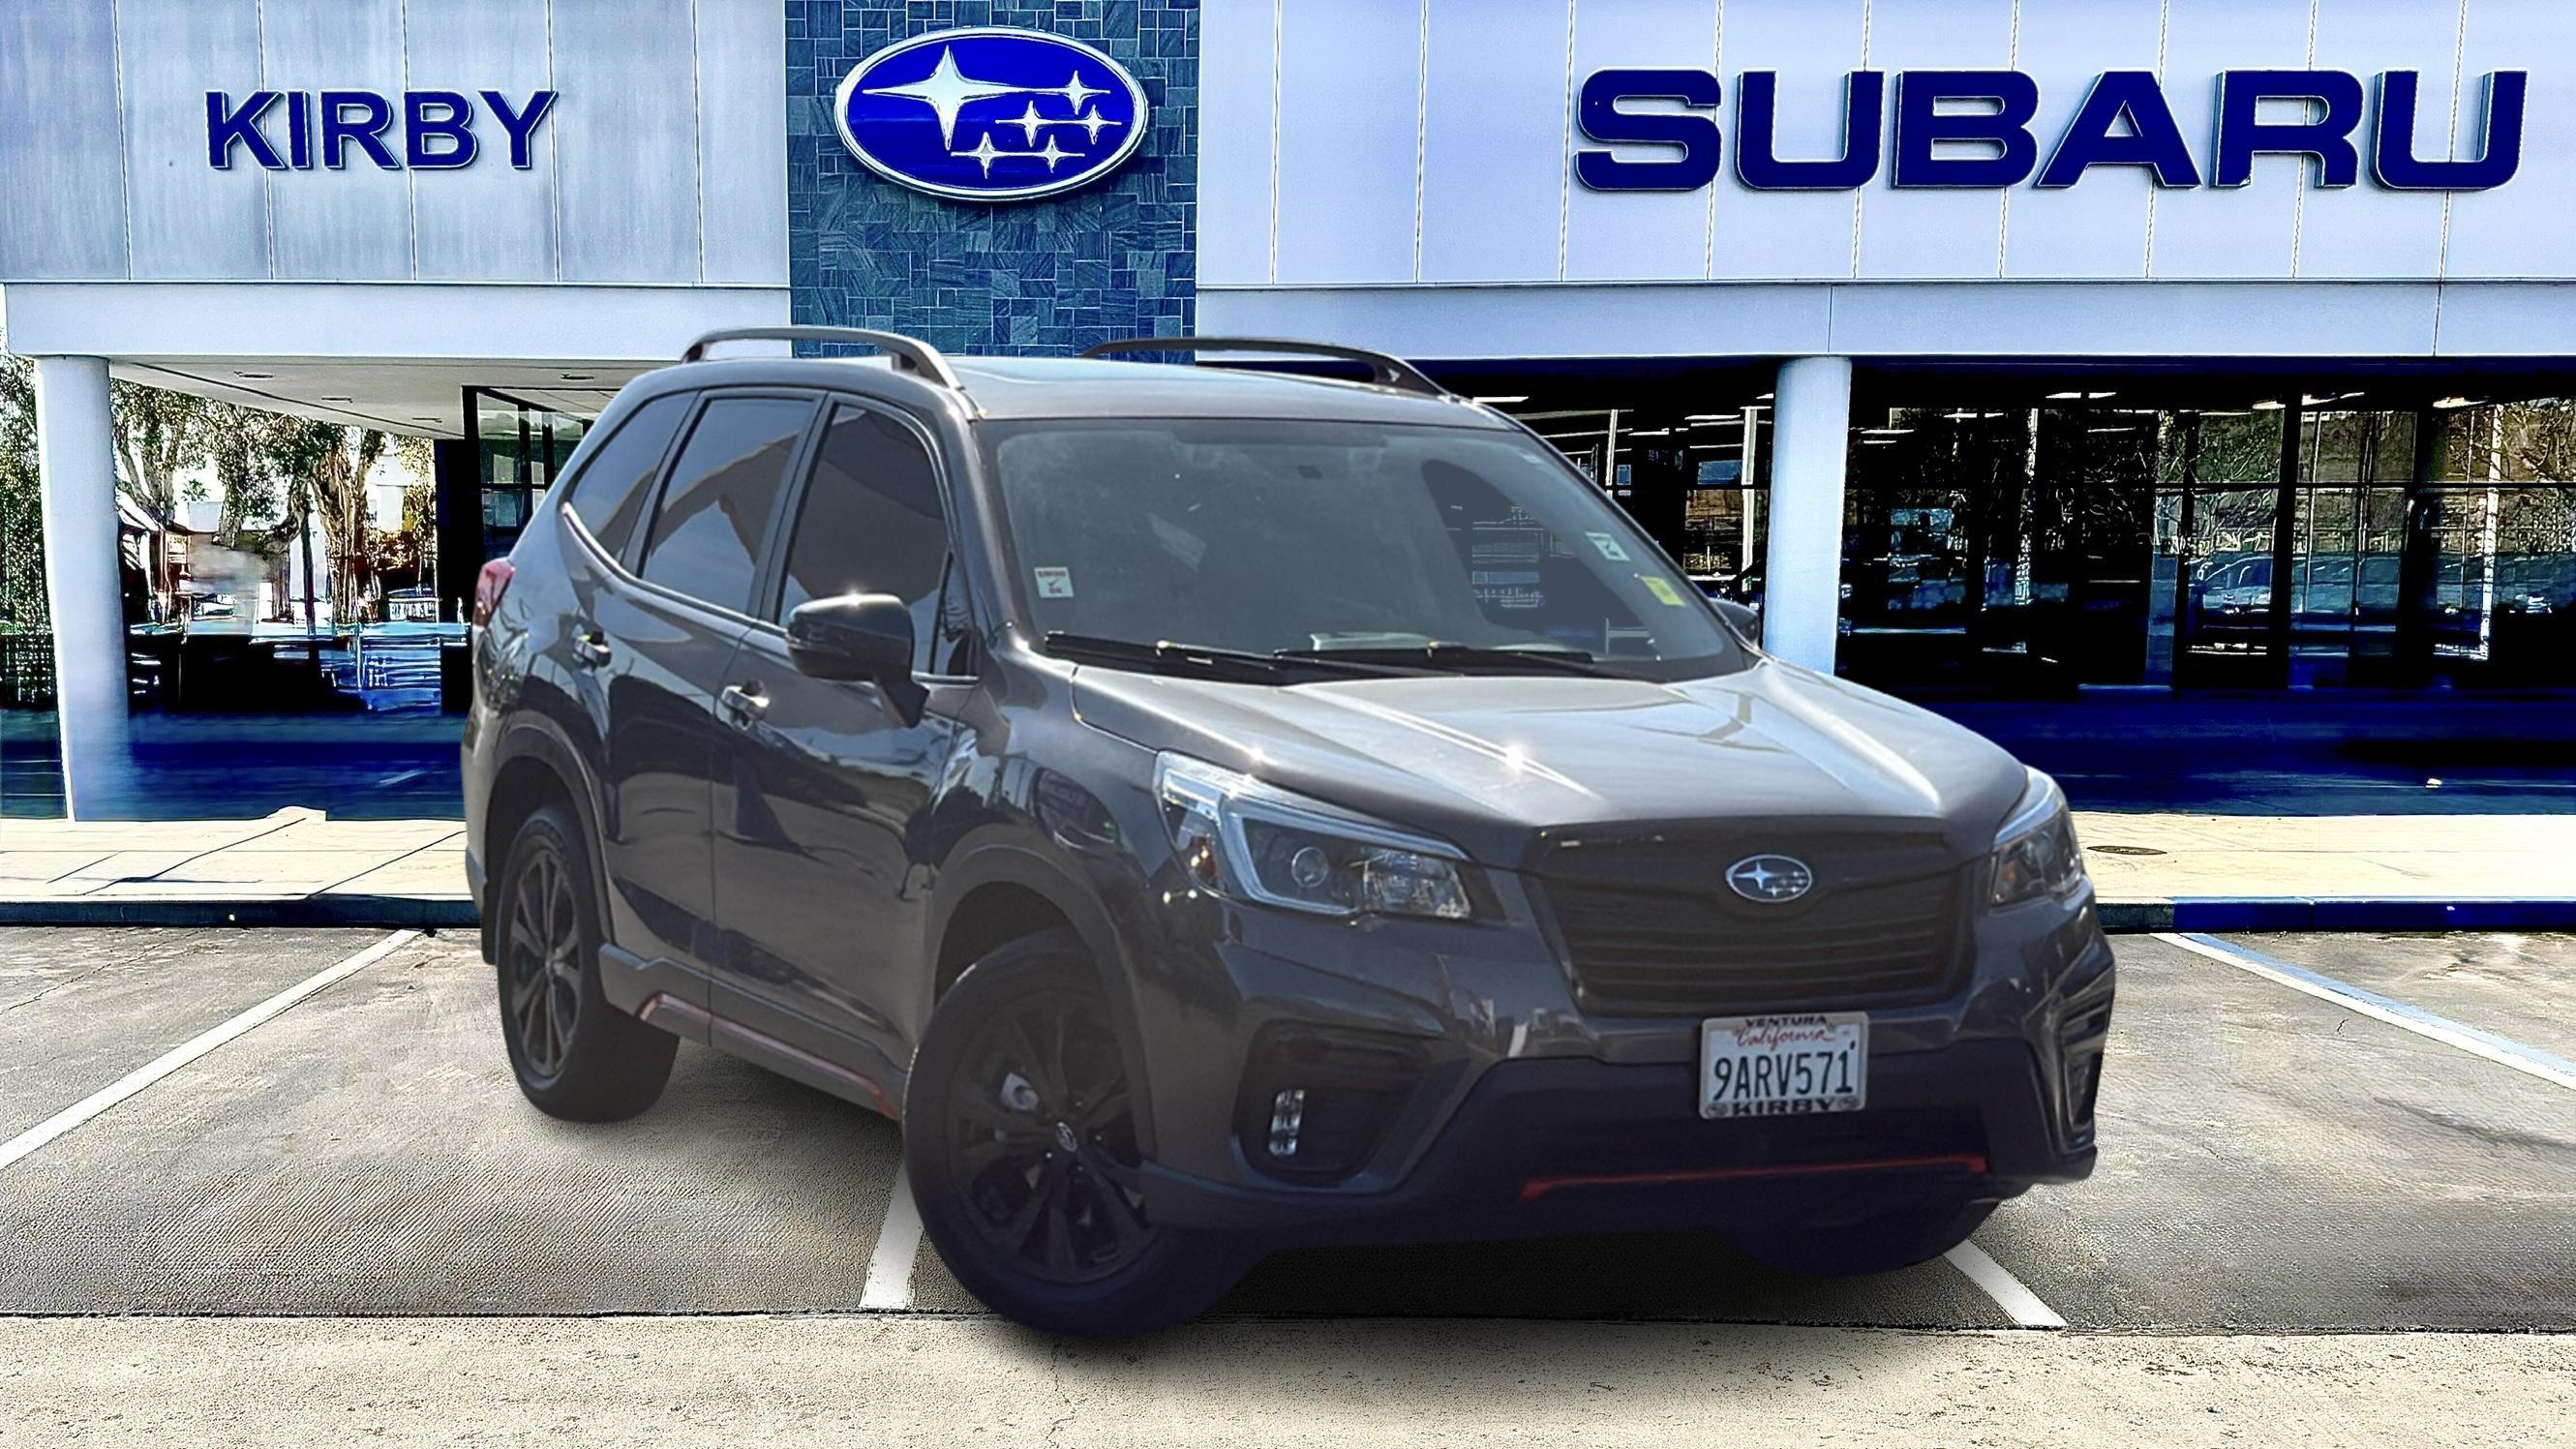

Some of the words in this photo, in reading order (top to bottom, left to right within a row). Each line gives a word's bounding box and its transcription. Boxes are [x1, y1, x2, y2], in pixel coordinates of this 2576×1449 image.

[205, 91, 559, 170] KIRBY
[1575, 69, 2528, 191] SUBARU
[1736, 1026, 1835, 1051] California
[1745, 1015, 1827, 1027] VENTURA
[1712, 1050, 1853, 1101] 9ARV571
[1732, 1098, 1834, 1116] KIRBY
